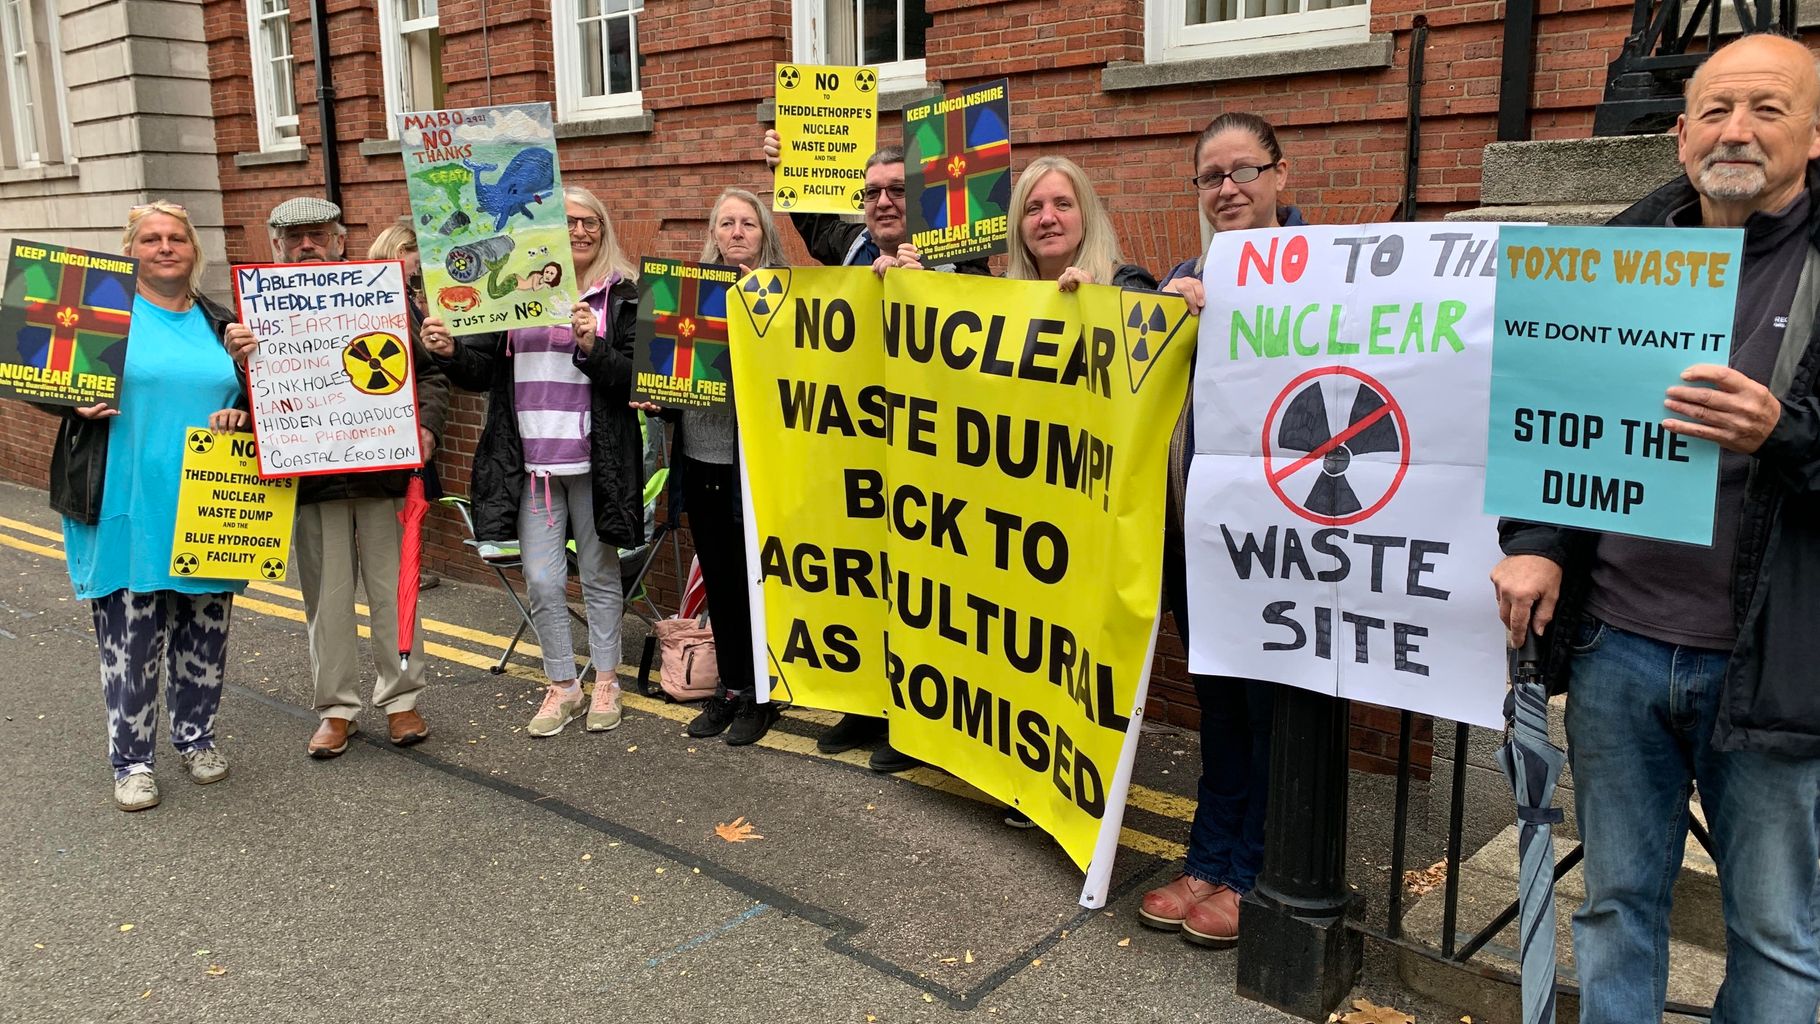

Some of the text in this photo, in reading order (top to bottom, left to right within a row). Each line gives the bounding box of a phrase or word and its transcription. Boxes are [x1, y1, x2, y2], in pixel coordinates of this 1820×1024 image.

[816, 73, 839, 90] NO
[779, 105, 872, 119] THEDDLETHORPE'S
[907, 86, 1004, 122] KEEP LINCOLNSHIRE
[405, 111, 463, 130] MABO
[803, 124, 849, 136] NUCLEAR
[422, 129, 452, 150] NO
[792, 141, 857, 153] WASTE DUMP
[413, 144, 472, 163] THANKS
[784, 167, 865, 179] BLUE HYDROGEN
[804, 184, 846, 196] FACILITY
[912, 216, 1006, 248] NUCLEAR FREE
[928, 243, 992, 260] www.gotec.org.uk
[934, 242, 960, 252] Guardians
[979, 236, 991, 244] East
[16, 246, 134, 274] KEEP LINCOLNSHIRE
[1237, 234, 1309, 287] NO
[1333, 234, 1404, 283] TO
[1506, 245, 1730, 289] TOXIC WASTE
[644, 262, 737, 283] KEEP LINCOLNSHIRE
[453, 315, 485, 327] JUST
[490, 312, 508, 322] SAY
[1229, 300, 1467, 360] NUCLEAR
[257, 335, 351, 356] TORNADOES
[1505, 319, 1725, 352] WE DONT WANT IT
[795, 298, 1116, 399] NO NUCLEAR
[0, 363, 116, 392] NUCLEAR FREE
[257, 369, 353, 397] SINKHOLES
[637, 373, 726, 396] NUCLEAR FREE
[26, 382, 57, 391] Guardians
[96, 390, 114, 398] Coast
[658, 389, 682, 397] Guardians
[263, 404, 414, 432] HIDDEN AQUADUCTS
[315, 425, 396, 444] PHENOMENA
[1514, 407, 1690, 462] STOP THE
[231, 440, 256, 458] NO
[344, 446, 415, 462] EROSION
[777, 379, 1113, 512] WASTE DUMP!
[213, 490, 265, 503] NUCLEAR
[1542, 469, 1644, 514] DUMP
[198, 506, 273, 521] WASTE DUMP
[844, 468, 1069, 584] BCK TO
[185, 532, 281, 548] BLUE HYDROGEN
[207, 551, 256, 563] FACILITY
[1220, 523, 1451, 601] WASTE
[760, 536, 1130, 734] AGRIULTURAL
[1263, 601, 1430, 677] SITE
[781, 618, 1105, 820] AS ROMISED
